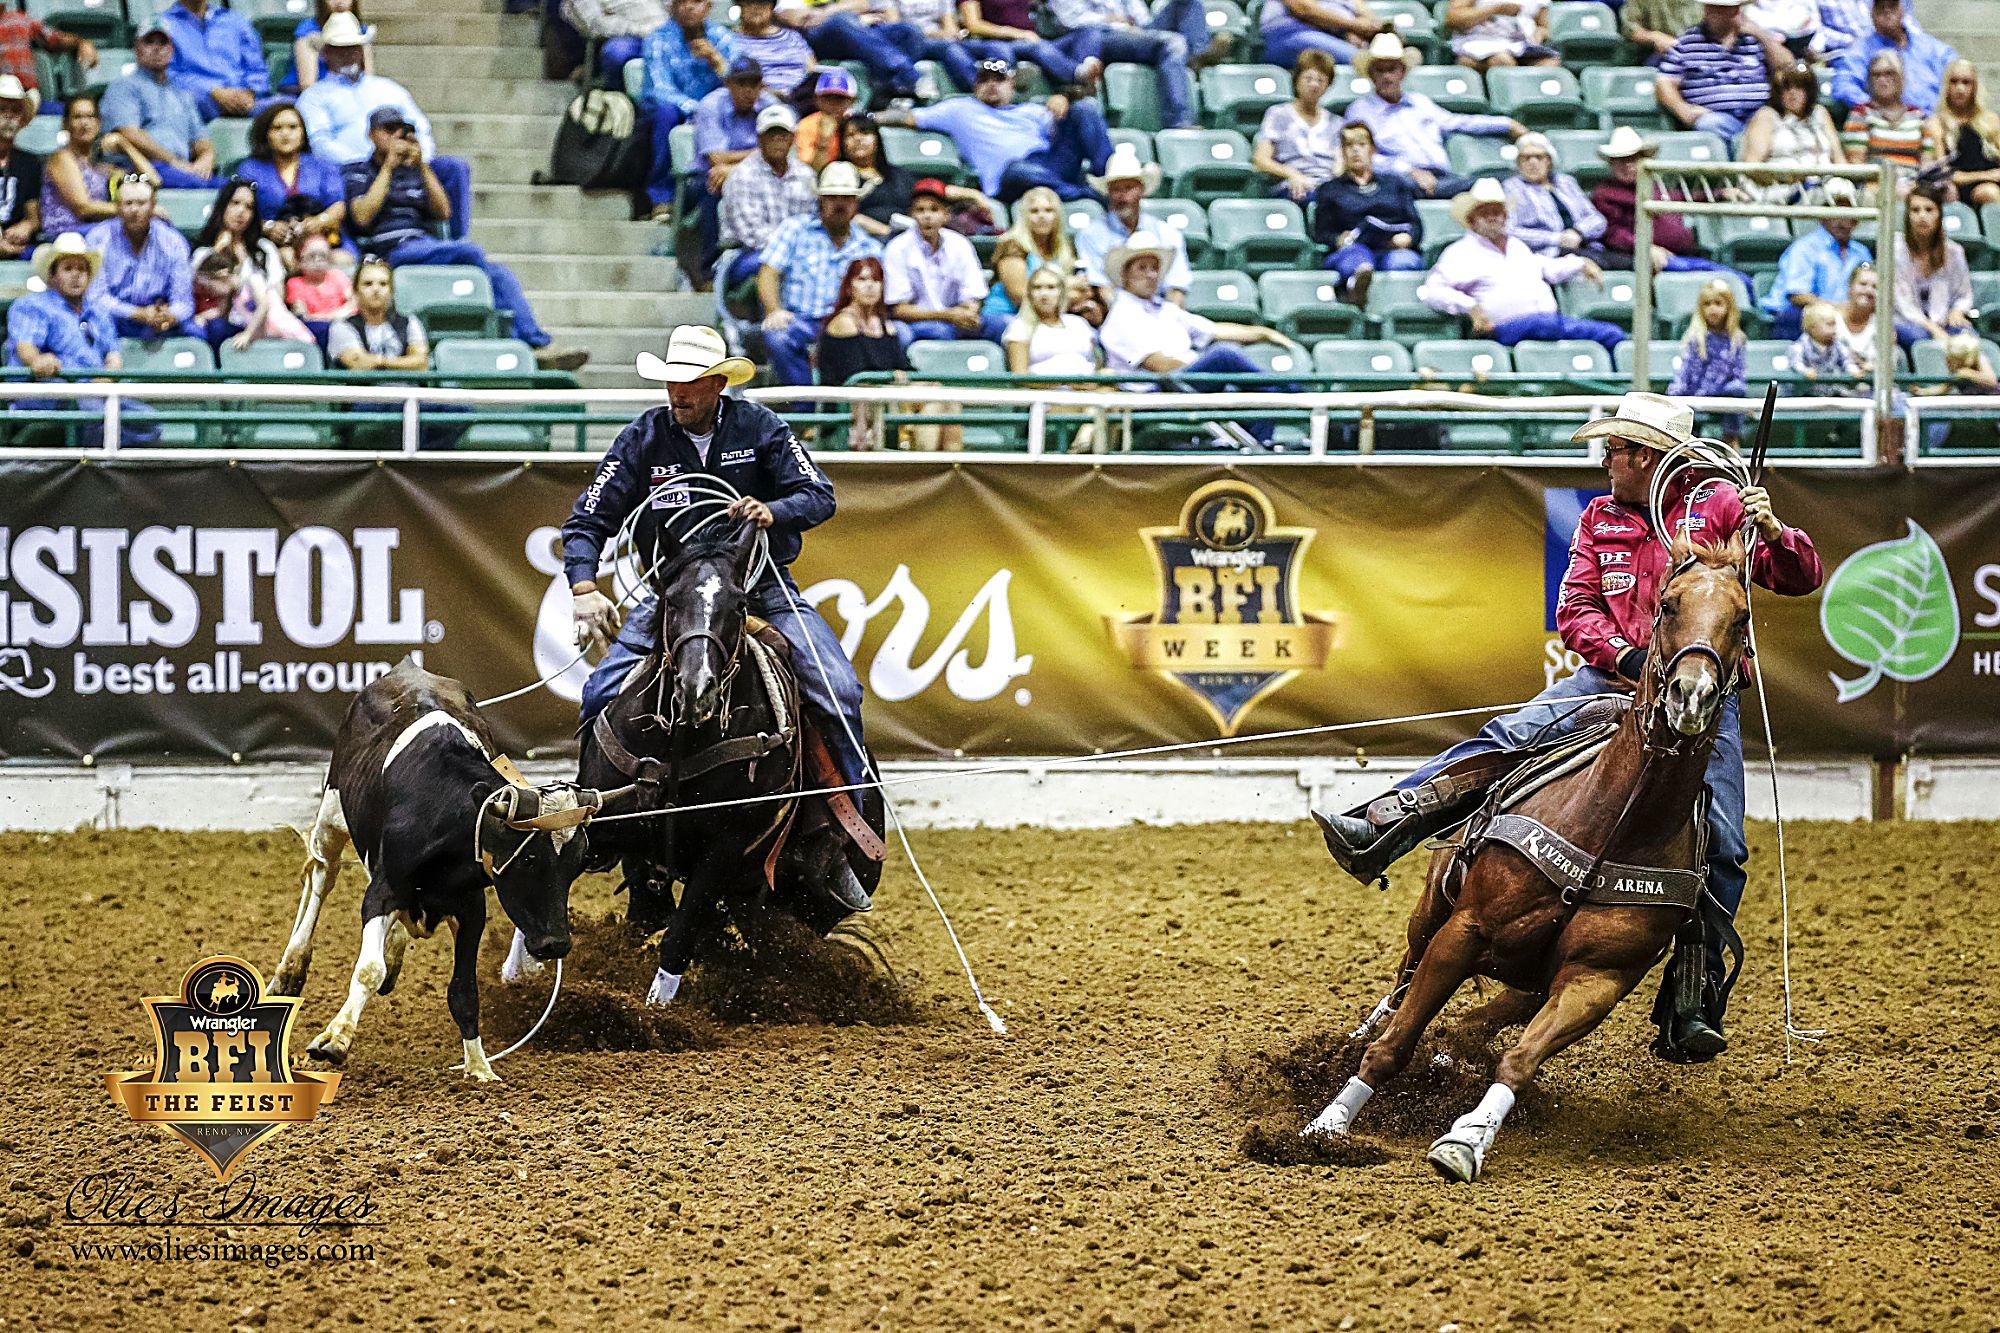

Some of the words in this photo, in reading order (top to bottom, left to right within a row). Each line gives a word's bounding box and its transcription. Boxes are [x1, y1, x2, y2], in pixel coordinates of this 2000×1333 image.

[583, 460, 621, 515] Wrangler
[0, 525, 425, 647] SISTOL
[1190, 549, 1266, 573] Wrangler
[1174, 566, 1282, 624] BFI
[74, 652, 175, 694] best
[1163, 639, 1292, 658] WEEK
[1521, 827, 1605, 888] RIVERBED
[1614, 878, 1664, 895] ARENA
